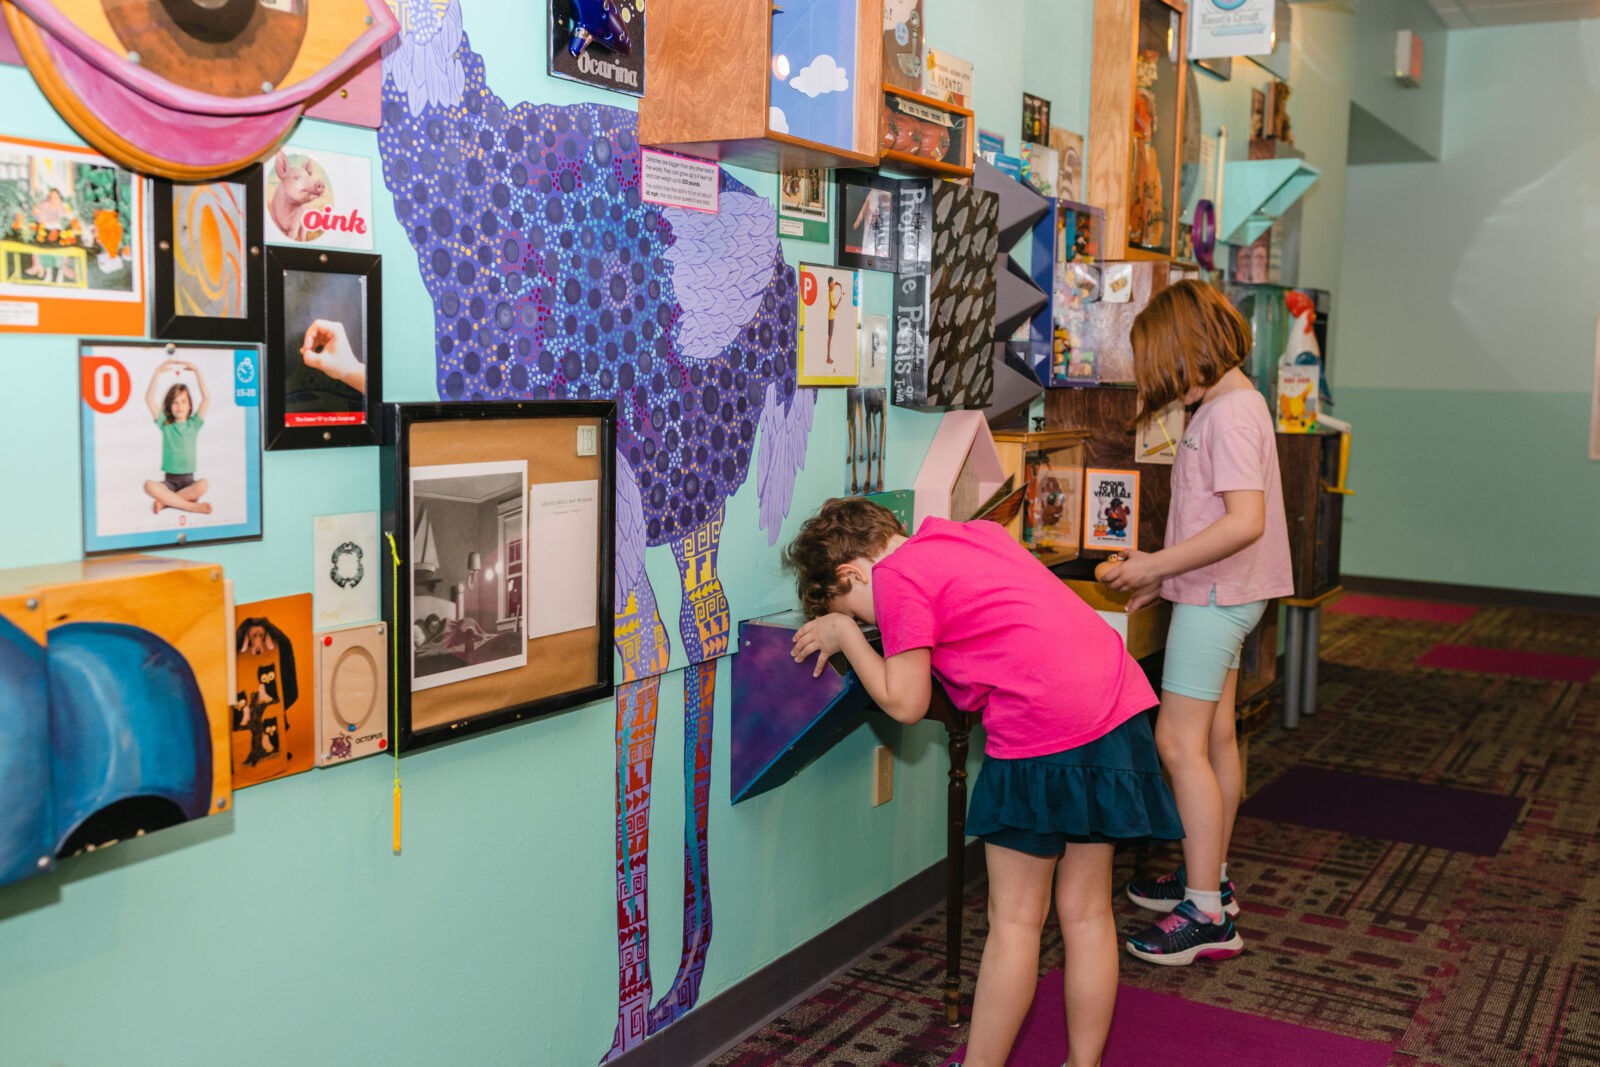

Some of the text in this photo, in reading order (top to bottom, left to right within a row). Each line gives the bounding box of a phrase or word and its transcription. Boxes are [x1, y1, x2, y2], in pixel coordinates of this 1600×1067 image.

[577, 51, 638, 87] Ocarina
[669, 160, 680, 168] bigger
[303, 206, 367, 235] oink
[803, 277, 813, 300] P
[895, 187, 926, 374] Projecile Ponts
[355, 731, 383, 744] OCTOPUS
